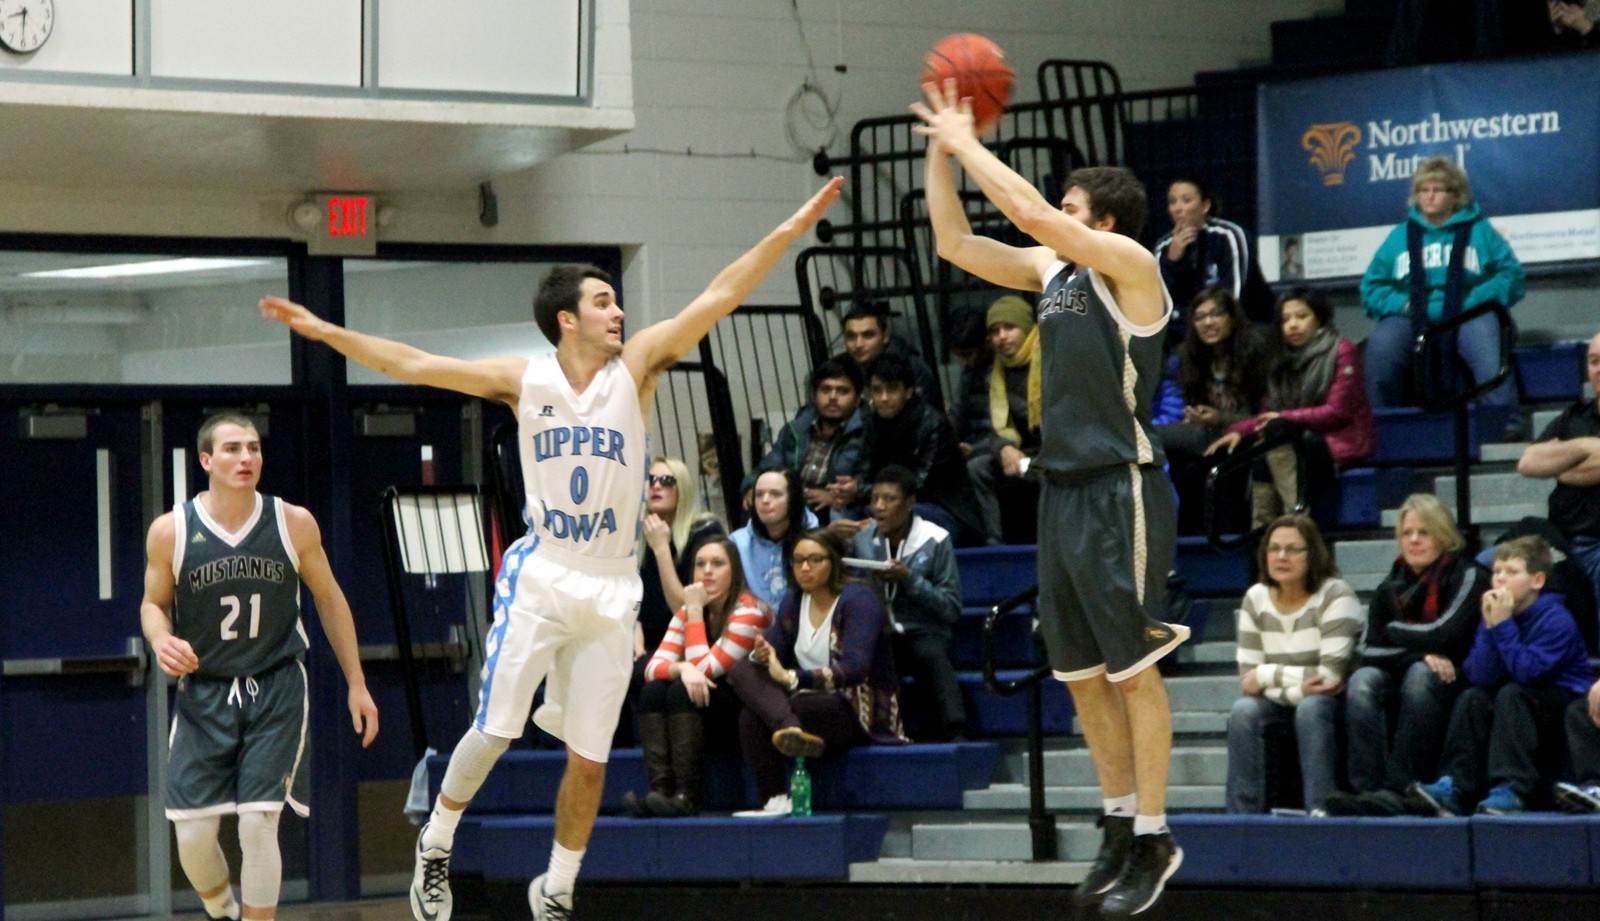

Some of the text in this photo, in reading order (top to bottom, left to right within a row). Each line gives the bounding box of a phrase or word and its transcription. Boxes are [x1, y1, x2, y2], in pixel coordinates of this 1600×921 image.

[1368, 110, 1561, 149] Northwestern
[1368, 143, 1466, 183] Mutl
[329, 197, 368, 236] EXIT
[532, 426, 628, 467] UPPER
[570, 465, 589, 505] 0
[540, 499, 618, 543] IOWA
[189, 555, 285, 594] MUSTANGS
[220, 593, 262, 641] 21
